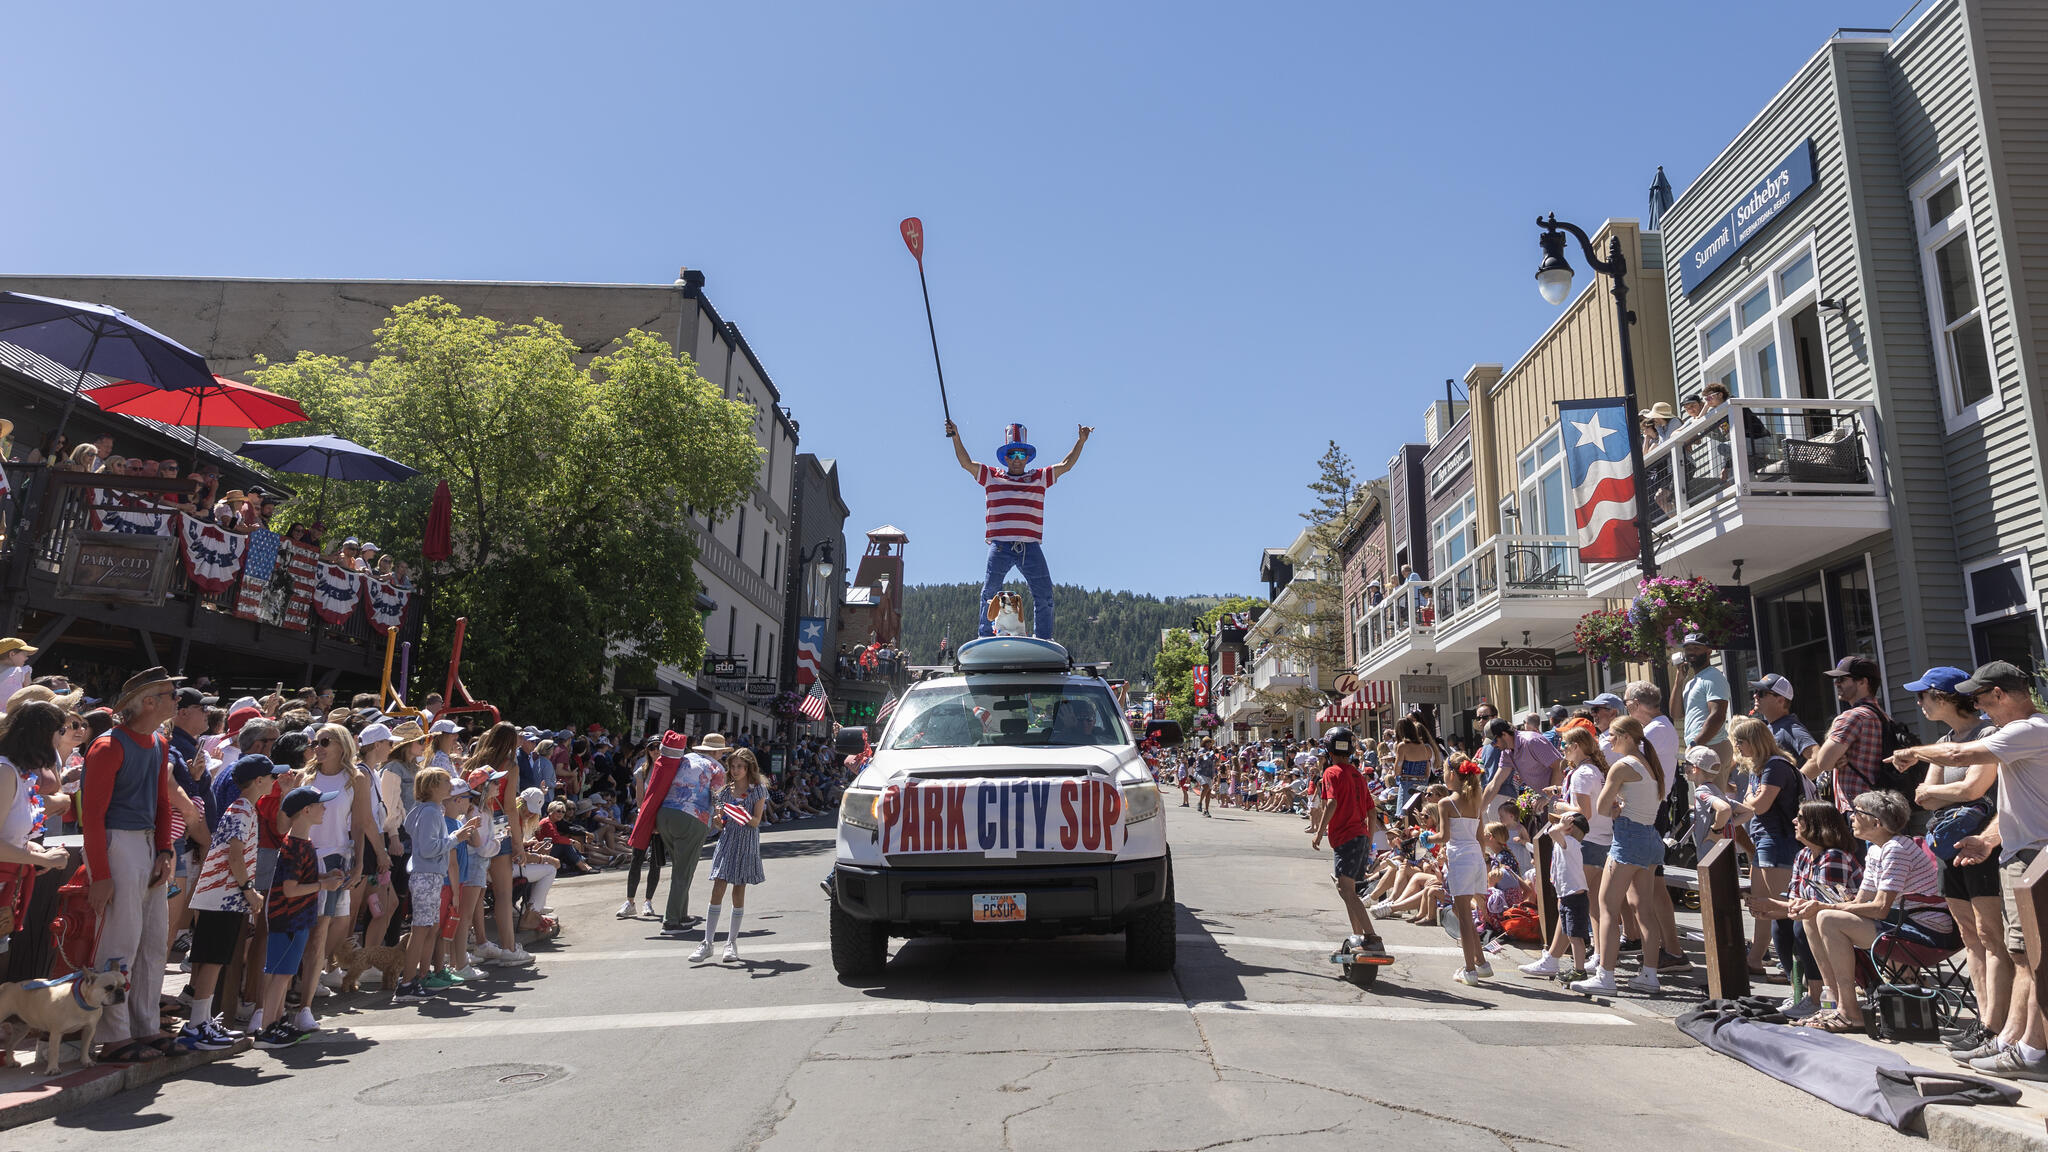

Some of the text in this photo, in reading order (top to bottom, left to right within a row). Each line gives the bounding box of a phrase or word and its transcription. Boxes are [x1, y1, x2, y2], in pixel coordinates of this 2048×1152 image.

[1695, 169, 1789, 269] Summit Sotheby's
[1739, 191, 1791, 241] INTERNATIONAL REALTY
[81, 554, 153, 569] PARK CITY
[715, 662, 734, 671] stio
[1485, 658, 1552, 668] OVERLAND
[1407, 685, 1441, 694] FLIGHT
[882, 780, 1121, 853] PARK CITY SUP
[983, 903, 1017, 918] PCSUP
